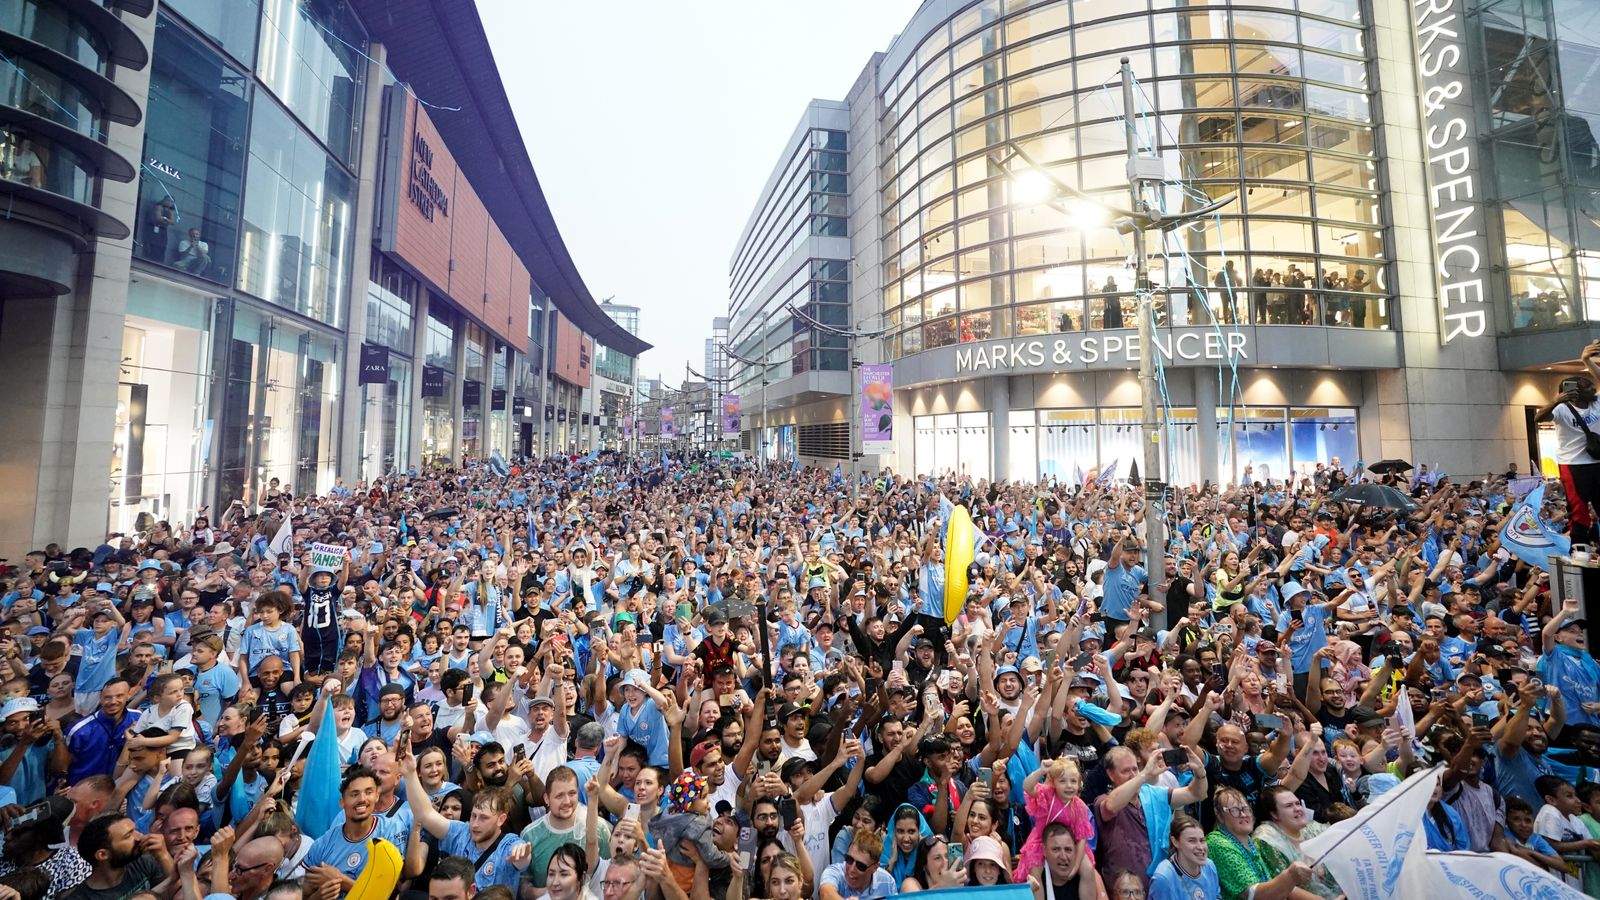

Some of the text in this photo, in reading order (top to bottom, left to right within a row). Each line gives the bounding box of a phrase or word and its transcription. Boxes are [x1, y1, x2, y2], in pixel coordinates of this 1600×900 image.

[1424, 81, 1463, 118] &
[150, 158, 181, 180] ZARA
[415, 132, 433, 171] NEW
[411, 183, 434, 223] STREET
[413, 159, 449, 218] CATHEDRAL
[1427, 118, 1487, 342] SPENCER
[956, 332, 1249, 373] MARKS & SPENCER
[312, 552, 343, 567] VAMOS!
[314, 544, 343, 555] GREALISH
[307, 600, 331, 629] 10
